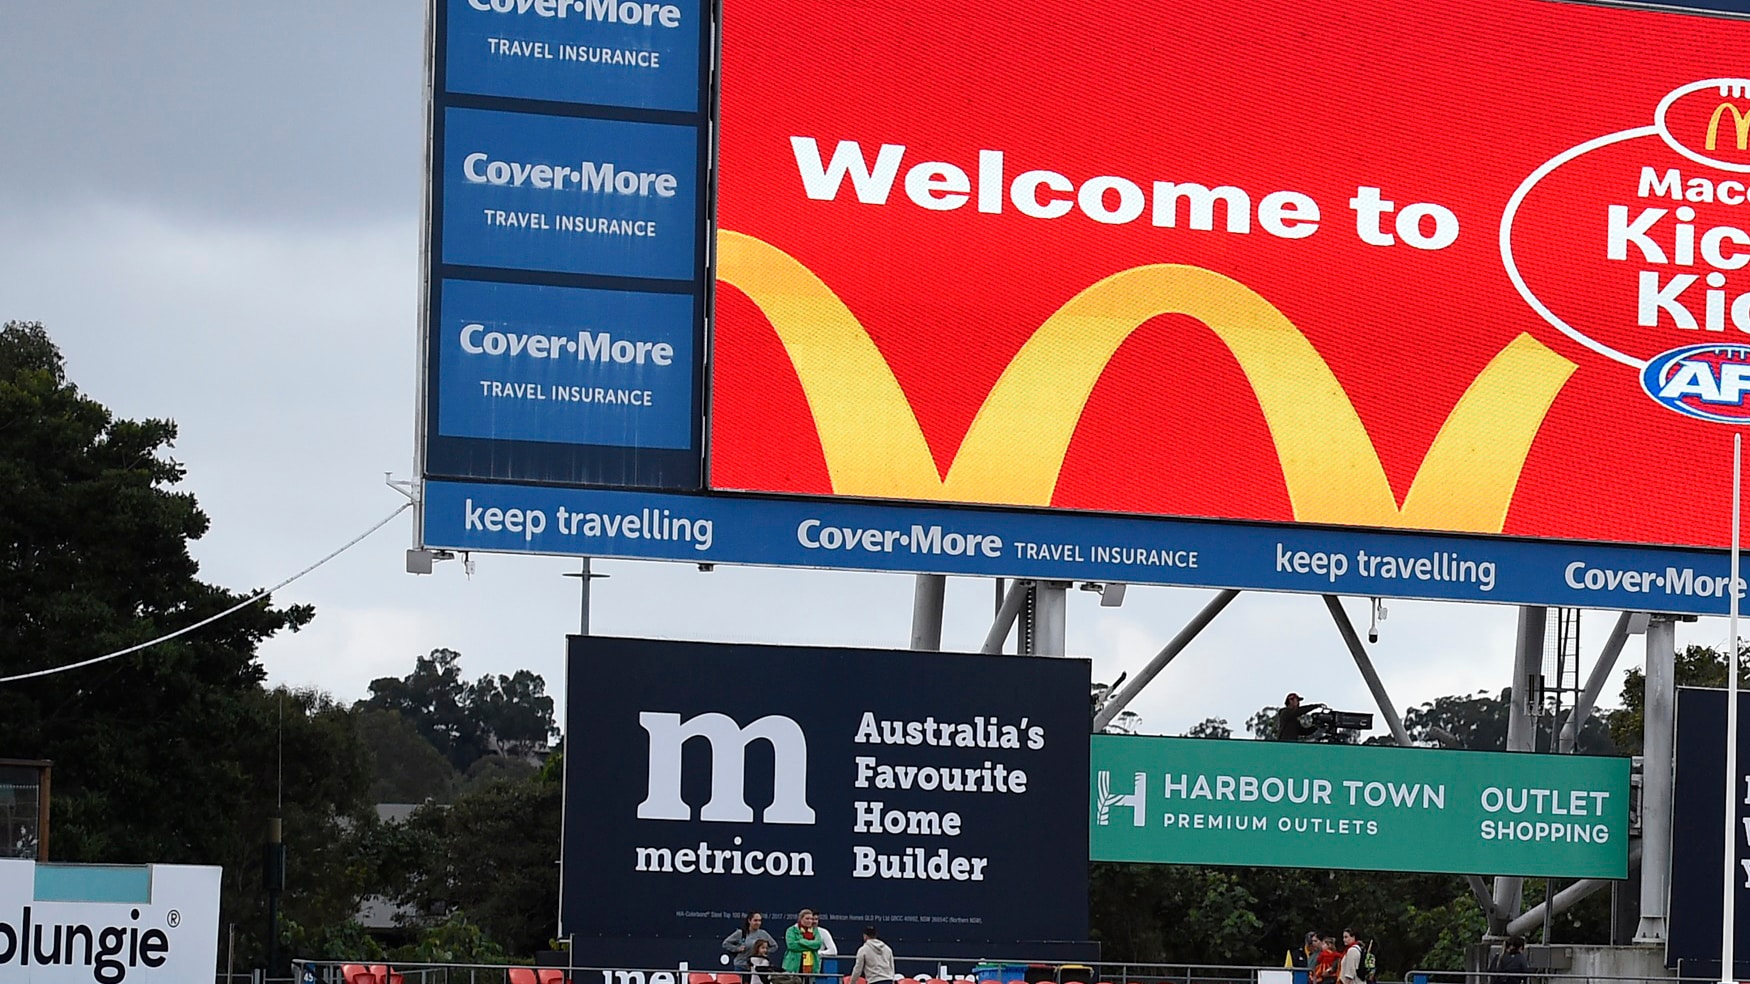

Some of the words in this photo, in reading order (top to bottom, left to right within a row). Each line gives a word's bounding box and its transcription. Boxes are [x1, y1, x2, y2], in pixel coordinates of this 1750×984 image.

[487, 38, 553, 59] TRAVEL
[560, 44, 660, 68] INSURANCE
[790, 135, 1321, 239] Welcome
[1349, 185, 1460, 250] to
[484, 209, 550, 230] TRAVEL
[556, 215, 656, 237] INSURANCE
[480, 380, 546, 401] TRAVEL
[552, 385, 652, 407] INSURANCE
[465, 498, 545, 541] keep
[556, 505, 713, 549] travelling
[1014, 542, 1085, 562] TRAVEL
[1091, 546, 1198, 568] INSURANCE
[1276, 542, 1348, 583] keep
[1356, 550, 1496, 592] travelling
[854, 711, 1045, 750] Australia's
[636, 711, 816, 825] m
[854, 756, 1028, 794] Favourite
[1164, 773, 1332, 806] HARBOUR
[1342, 780, 1445, 809] TOWN
[1480, 786, 1610, 816] OUTLET
[853, 801, 962, 836] Home
[1164, 813, 1267, 832] PREMIUM
[1278, 817, 1378, 835] OUTLETS
[1480, 820, 1610, 845] SHOPPING
[635, 836, 815, 877] metricon
[852, 846, 988, 882] Builder
